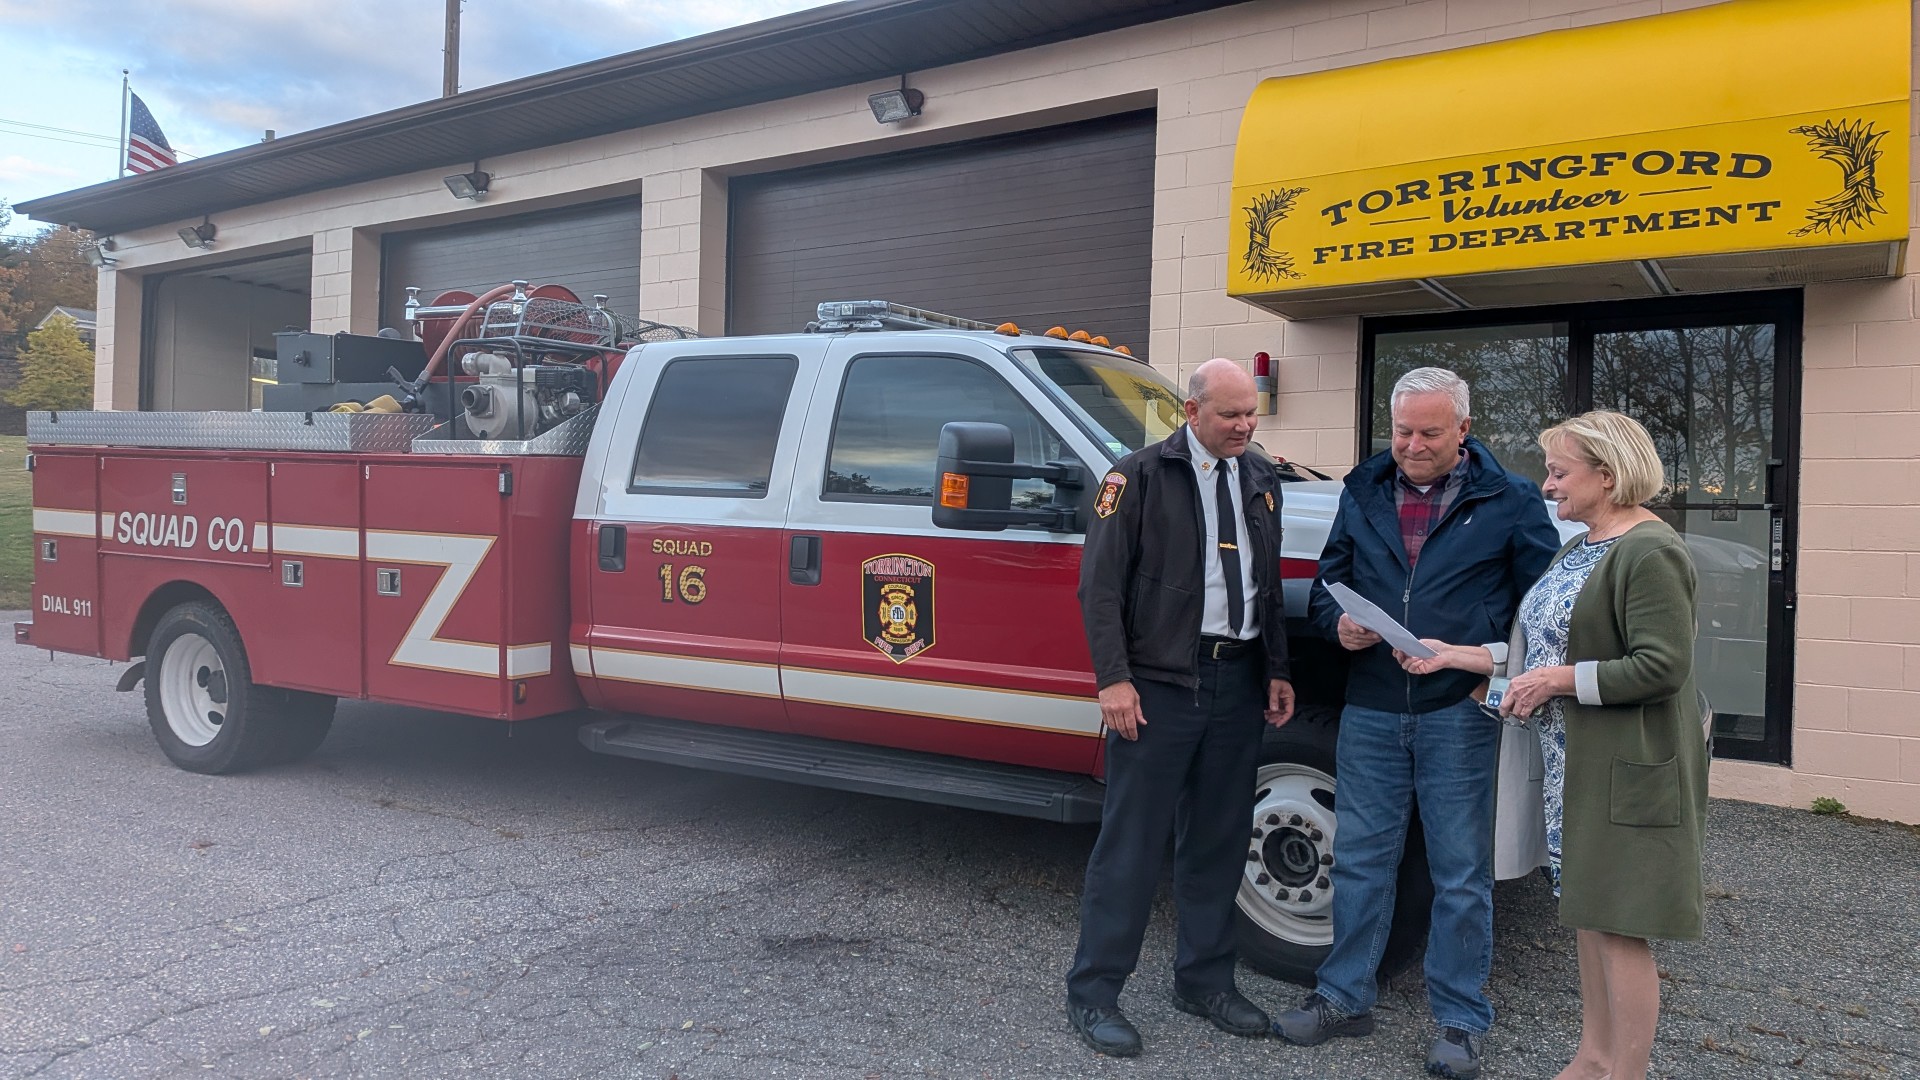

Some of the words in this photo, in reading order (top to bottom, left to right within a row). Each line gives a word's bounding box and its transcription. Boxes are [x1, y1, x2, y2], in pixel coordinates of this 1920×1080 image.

[1321, 150, 1772, 226] TORRINGFORD
[1443, 188, 1629, 223] Volunteer
[1313, 237, 1414, 264] FIRE
[1428, 201, 1781, 252] DEPARTMENT
[365, 465, 370, 480] 9
[117, 511, 198, 548] SQUAD
[207, 516, 248, 553] CO.
[652, 538, 712, 556] SQUAD
[864, 557, 932, 577] TORRINGTON
[659, 563, 706, 604] 16
[42, 594, 71, 615] DIAL
[73, 599, 92, 617] 911
[874, 636, 894, 654] FIRE
[904, 638, 925, 657] DEPT
